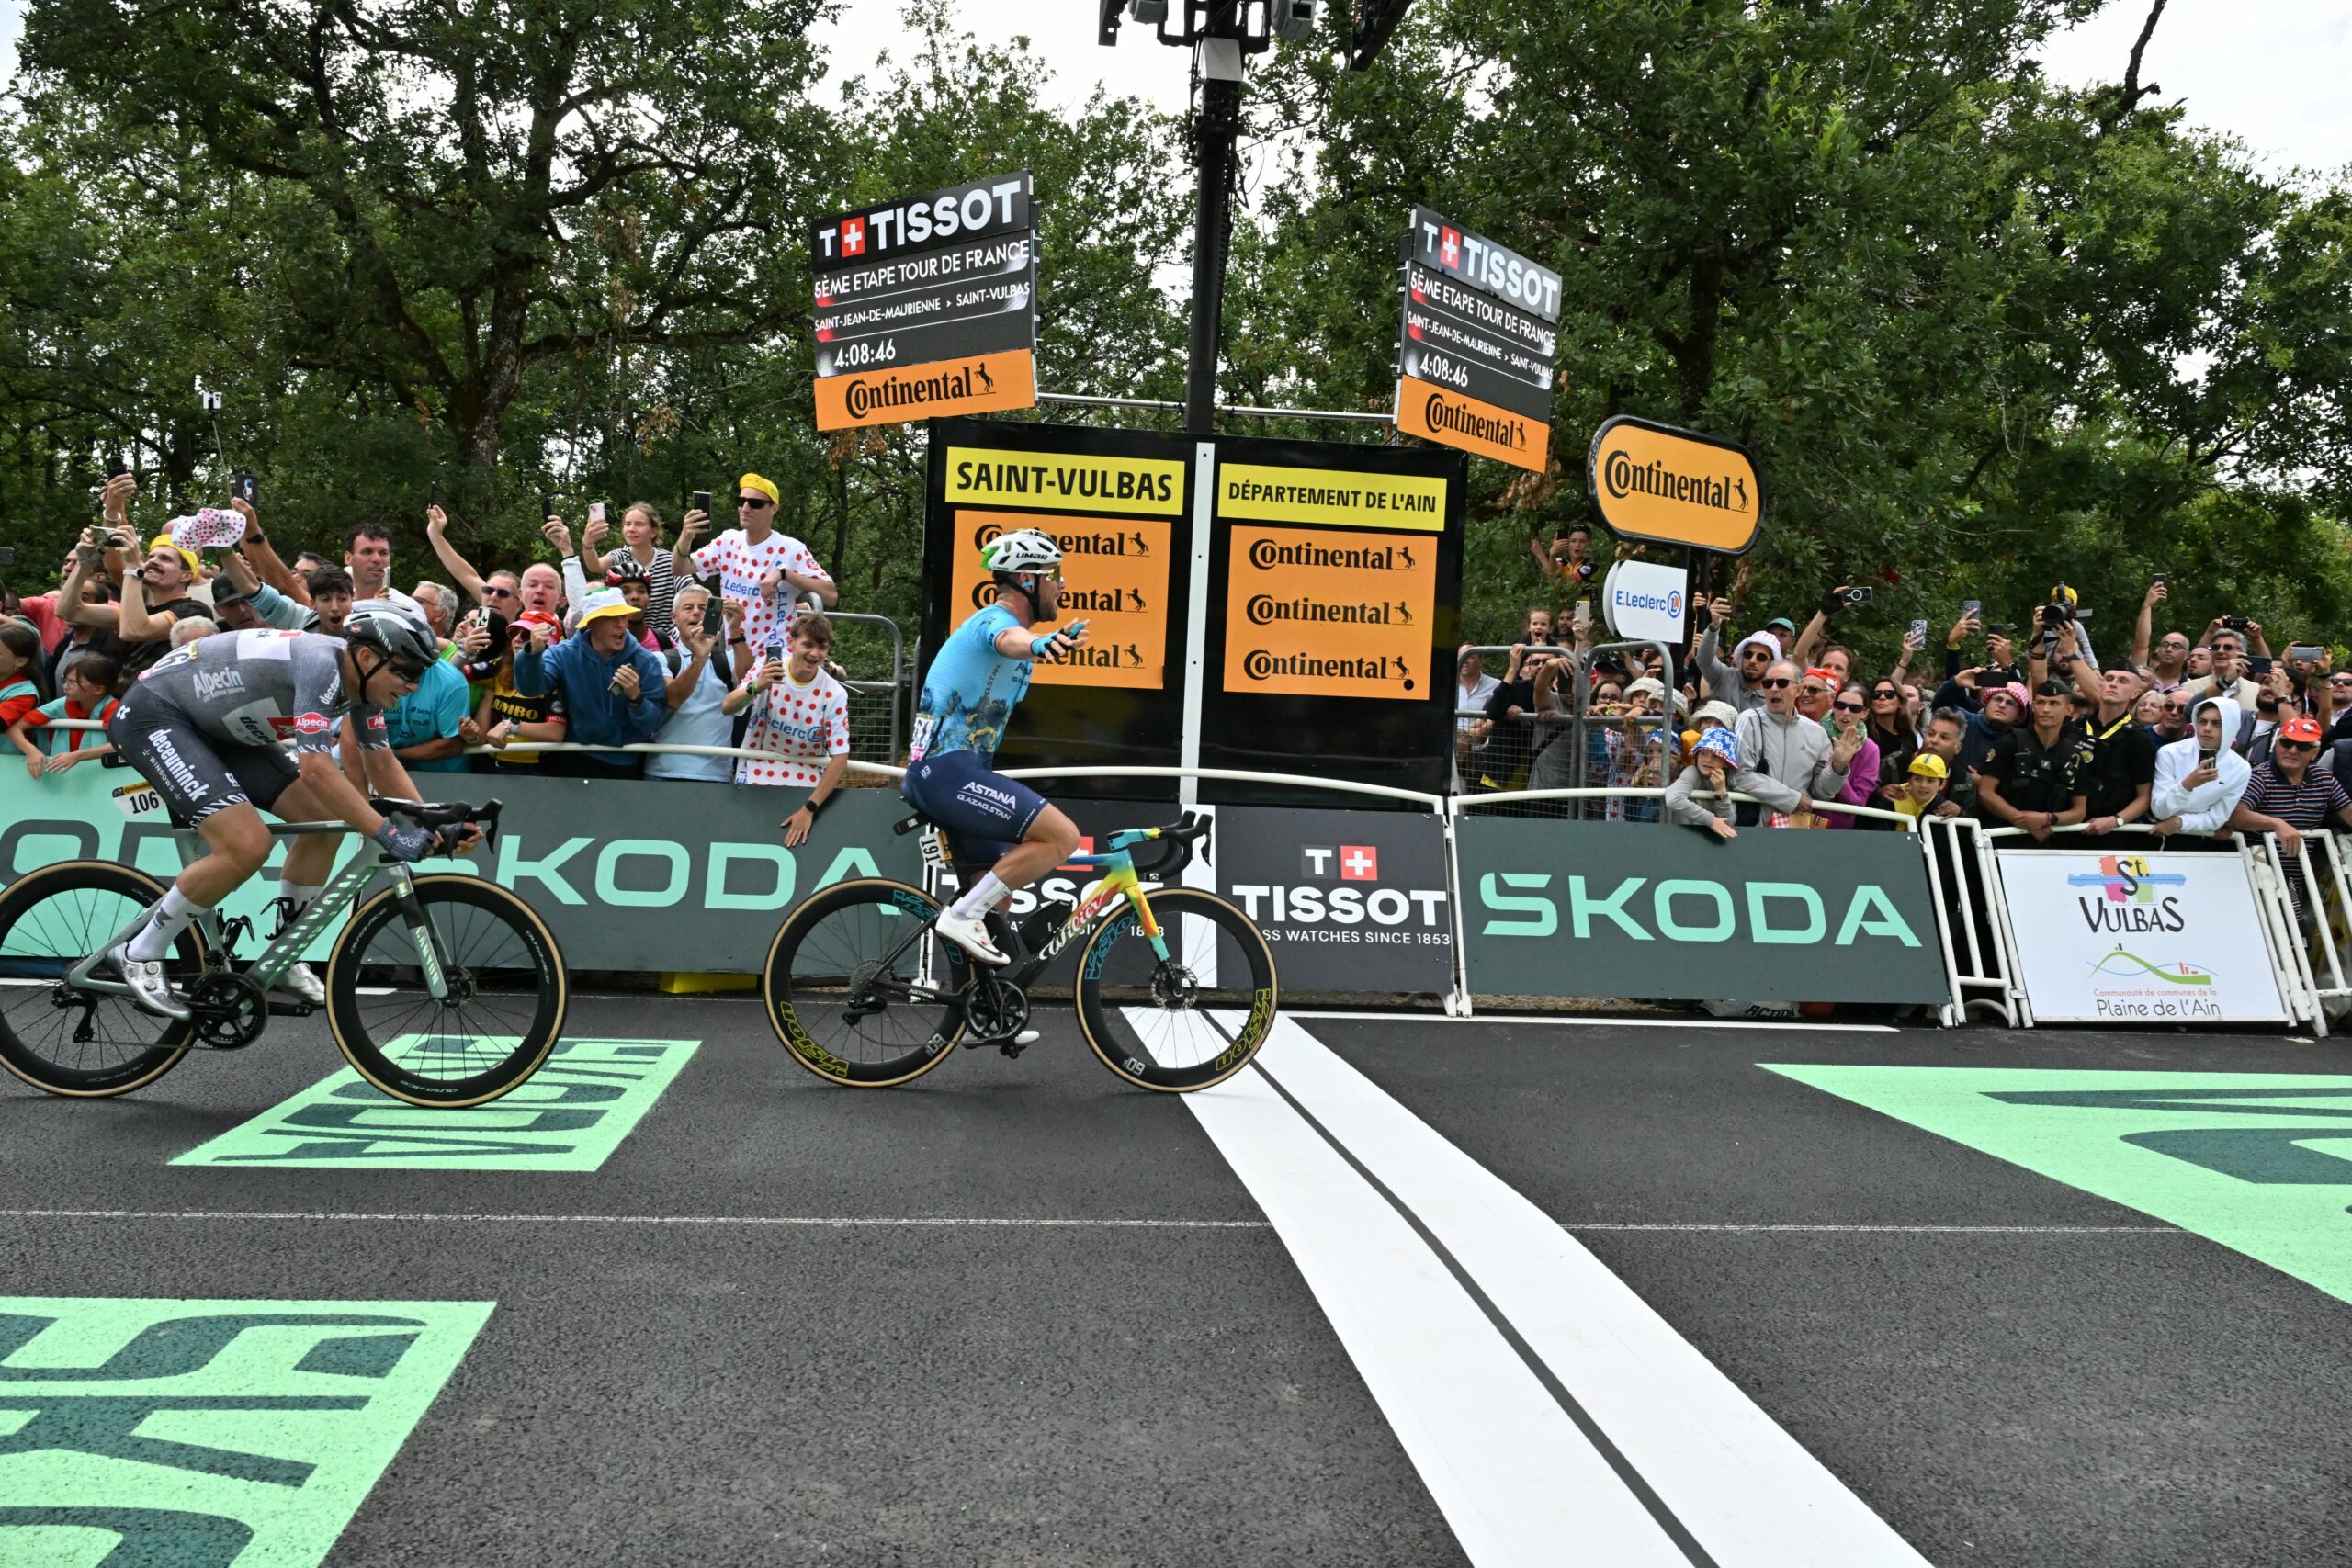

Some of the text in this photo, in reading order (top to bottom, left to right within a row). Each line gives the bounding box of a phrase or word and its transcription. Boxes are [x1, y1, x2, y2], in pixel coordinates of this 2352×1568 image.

[869, 180, 1021, 250] TISSOT
[814, 239, 1030, 299] 5ÈME ETAPE TOUR DE FRANCE
[1464, 236, 1559, 313] TISSOT
[814, 282, 1030, 332] SAINT-JEAN-DE-MAURIENNE SAINT-VULBAS
[1410, 267, 1555, 350] 5ÈME ETAPE TOUR DE FRANCE
[834, 338, 896, 368] 4:08:46
[1408, 311, 1554, 380] SAINT-JEAN-DE-MAURIENNE SAINT-VULBAS
[1419, 352, 1468, 388] 4:08:46
[845, 367, 973, 419] Continental
[1425, 392, 1515, 448] Continental
[956, 461, 1173, 502] SAINT-VULBAS
[1228, 479, 1437, 513] DÉPARTEMENT DE L'AIN
[1604, 450, 1731, 510] Continental
[1249, 538, 1393, 570] Continental
[1246, 593, 1390, 626] Continental
[1616, 590, 1666, 612] E.Leclerc
[1243, 649, 1387, 681] Continental
[192, 667, 243, 699] Alpecin
[296, 718, 328, 728] Alpecin
[492, 698, 538, 720] JUMBO
[148, 728, 210, 802] deceuninck
[149, 756, 175, 793] WINDOWS
[129, 791, 159, 814] 106
[963, 782, 1016, 809] ASTANA
[921, 838, 941, 863] 191
[2117, 859, 2150, 896] St.
[1232, 885, 1447, 926] TISSOT
[2079, 897, 2185, 933] VULBAS
[1286, 930, 1360, 943] WATCHES
[1365, 931, 1411, 944] SINCE
[1416, 933, 1450, 945] 1853
[907, 988, 935, 1000] ASTANA
[2093, 988, 2143, 997] Communauté
[2145, 988, 2154, 997] de
[2197, 988, 2208, 997] de
[2096, 998, 2222, 1017] Plaine de l'Ain
